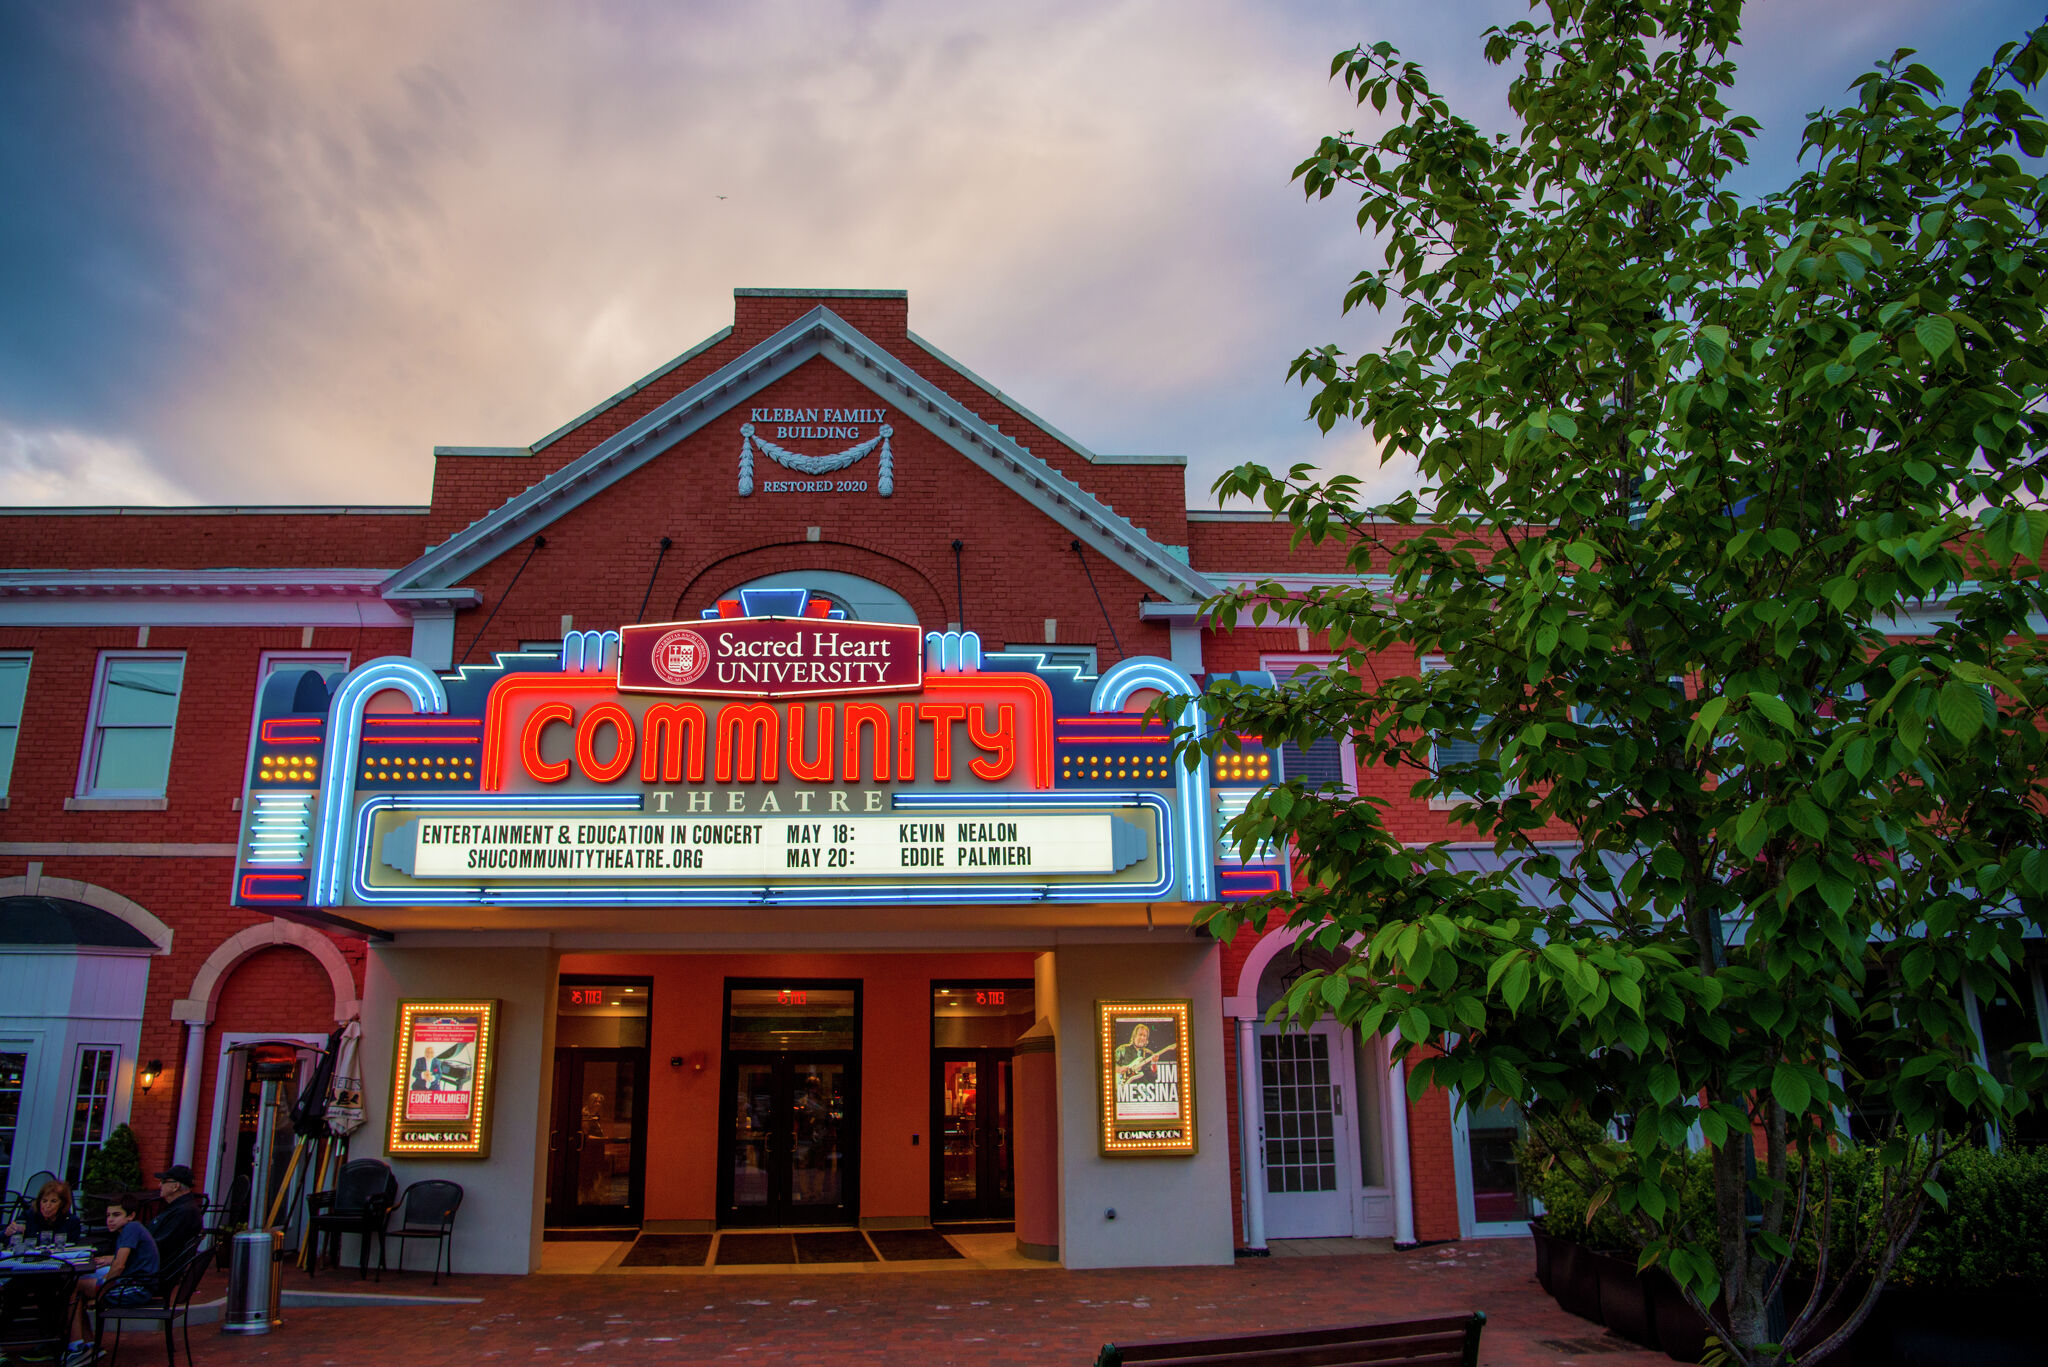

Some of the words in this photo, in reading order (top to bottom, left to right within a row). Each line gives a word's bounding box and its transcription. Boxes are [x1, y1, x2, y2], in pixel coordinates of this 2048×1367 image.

[751, 408, 819, 423] KLEBAN
[823, 408, 887, 423] FAMILY
[777, 426, 860, 439] BUILDING
[763, 480, 834, 492] RESTORED
[836, 480, 868, 492] 2020
[717, 631, 804, 658] Sacred
[812, 632, 892, 658] Heart
[716, 661, 892, 683] UNIVERSITY
[520, 701, 1017, 784] COMMUNITY
[653, 790, 884, 813] THEATRE
[422, 825, 554, 845] ENTERTAINMENT
[557, 825, 572, 845] &
[577, 825, 665, 845] EDUCATION
[670, 825, 687, 845] IN
[692, 824, 763, 844] CONCERT
[786, 824, 822, 844] MAY
[832, 824, 855, 844] 18:
[899, 823, 945, 843] KEVIN
[958, 822, 1018, 843] NEALON
[467, 848, 704, 869] SHUCOMMUNITYTHEATRE.ORG
[786, 848, 821, 868] MAY
[827, 847, 855, 868] 20:
[901, 847, 945, 867] EDDIE
[958, 846, 1032, 867] PALMIERI
[1155, 1064, 1178, 1083] JIM
[411, 1093, 432, 1104] EDDIE
[433, 1093, 469, 1104] PALMIERI
[1117, 1083, 1179, 1102] MESSINA
[404, 1132, 442, 1141] COMING
[443, 1132, 469, 1141] SOON
[1118, 1130, 1155, 1140] COMING
[1156, 1129, 1181, 1139] SOON
